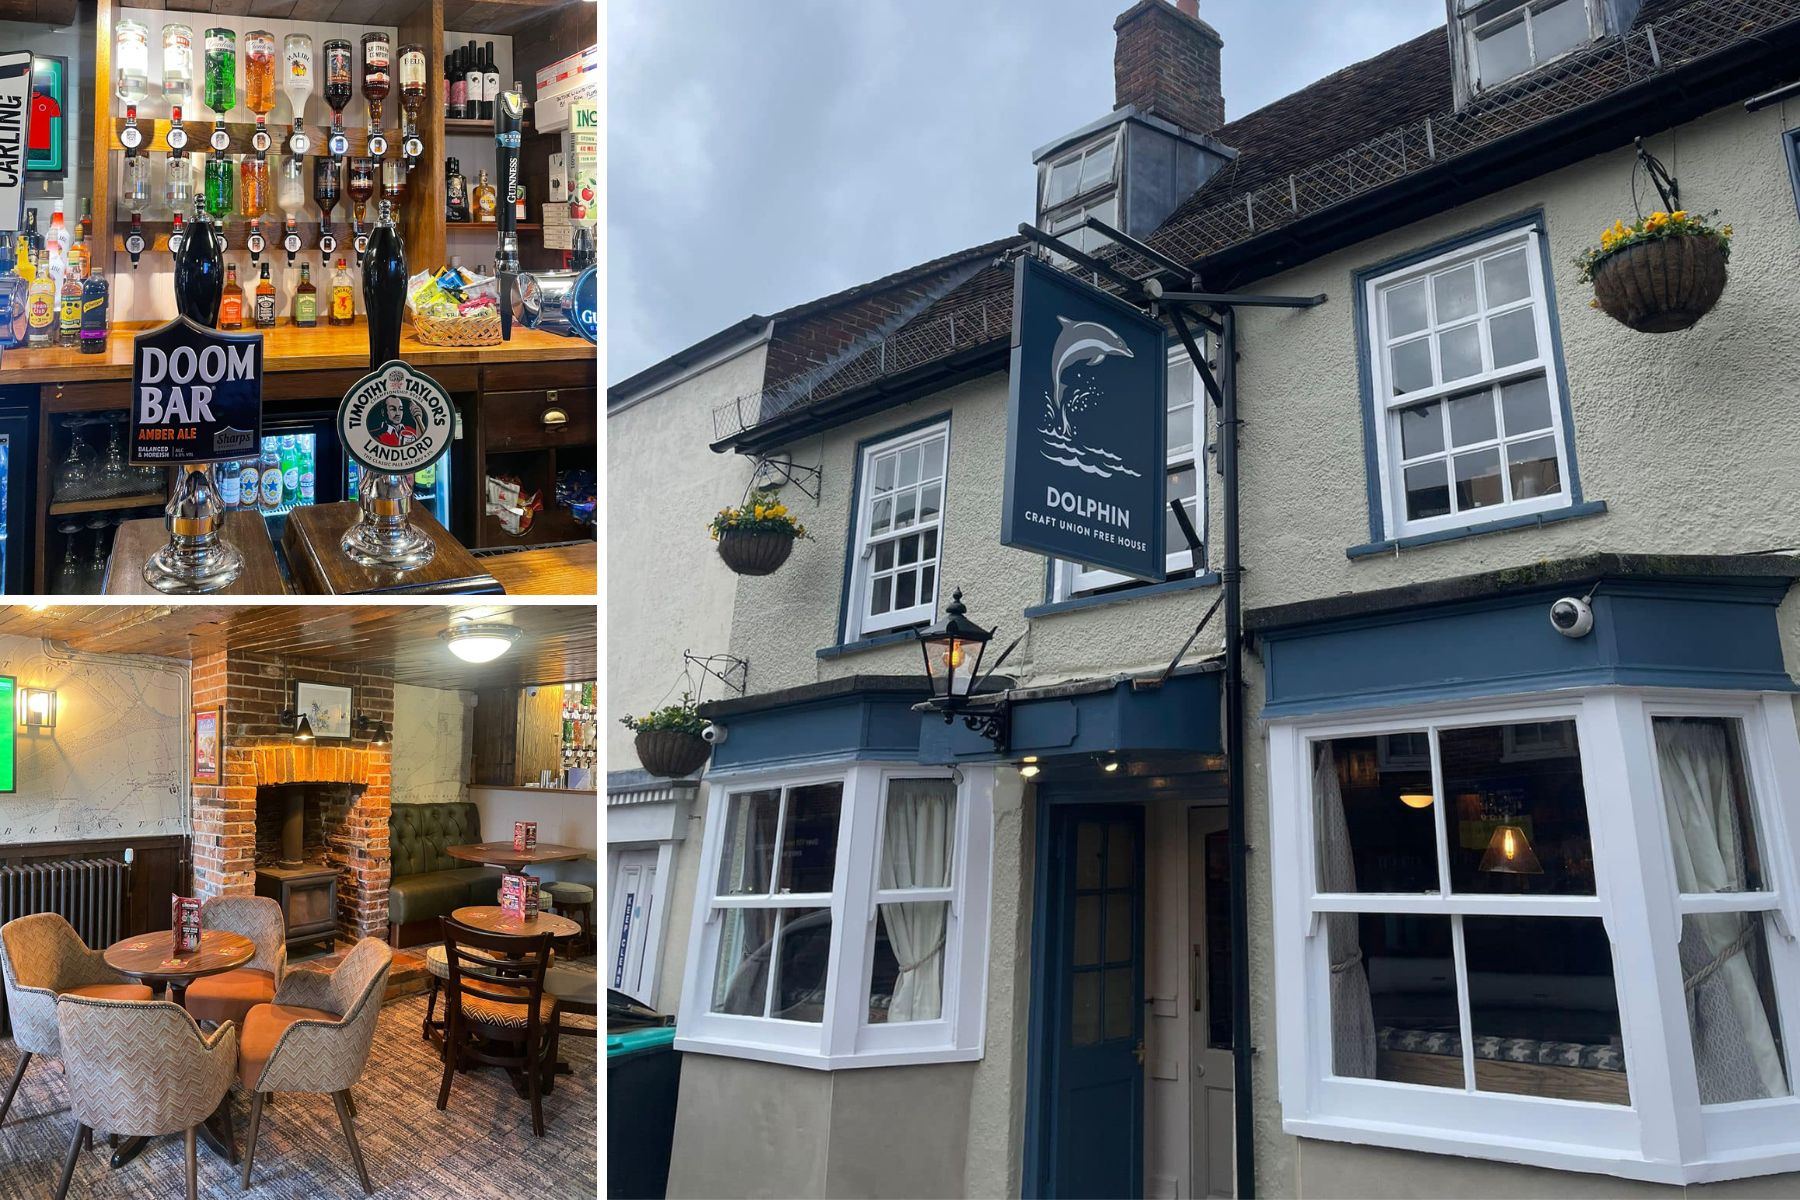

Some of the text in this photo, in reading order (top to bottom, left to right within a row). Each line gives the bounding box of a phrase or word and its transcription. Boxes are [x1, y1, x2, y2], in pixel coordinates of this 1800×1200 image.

[287, 51, 311, 63] MALIBU
[368, 45, 389, 53] SOTHERN
[0, 95, 22, 188] CARLING
[507, 157, 518, 203] GUINNESS
[141, 344, 256, 384] DOOM
[139, 385, 216, 425] BAR
[349, 378, 446, 429] TIMOTHY TAYLOR'S
[370, 390, 409, 404] CHAMPIONSHIP
[138, 427, 197, 441] AMBER ALE
[363, 436, 433, 460] LANDLORD
[363, 452, 372, 462] THE
[372, 459, 391, 467] CLASSIC
[1046, 485, 1130, 530] DOLPHIN
[1024, 511, 1147, 552] CRAFT UNION FREE HOUSE
[615, 897, 633, 985] KEEP CLEAR
